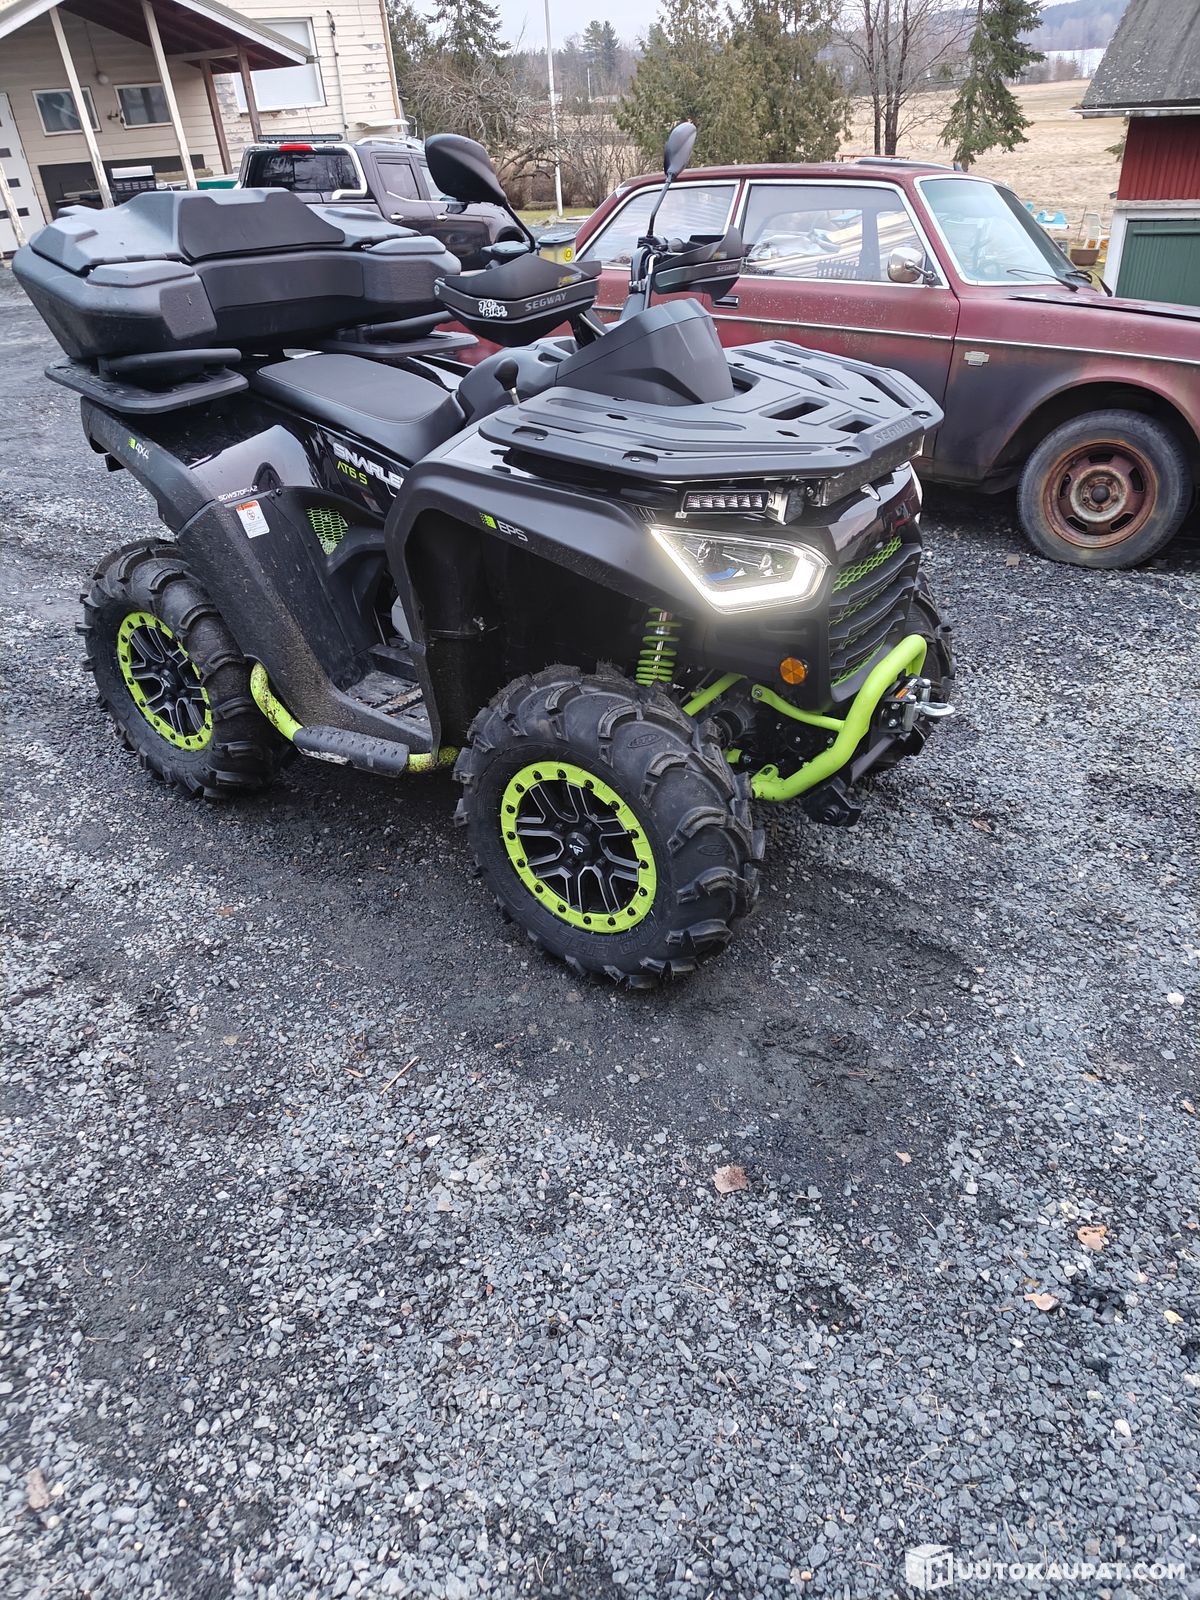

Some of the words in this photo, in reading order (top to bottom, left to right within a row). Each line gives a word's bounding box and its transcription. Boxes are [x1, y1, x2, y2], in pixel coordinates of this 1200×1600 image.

[525, 292, 567, 312] SEGWAY
[332, 442, 404, 490] SNARLE
[337, 461, 357, 479] AT6
[359, 472, 368, 485] S
[496, 520, 529, 542] EPS
